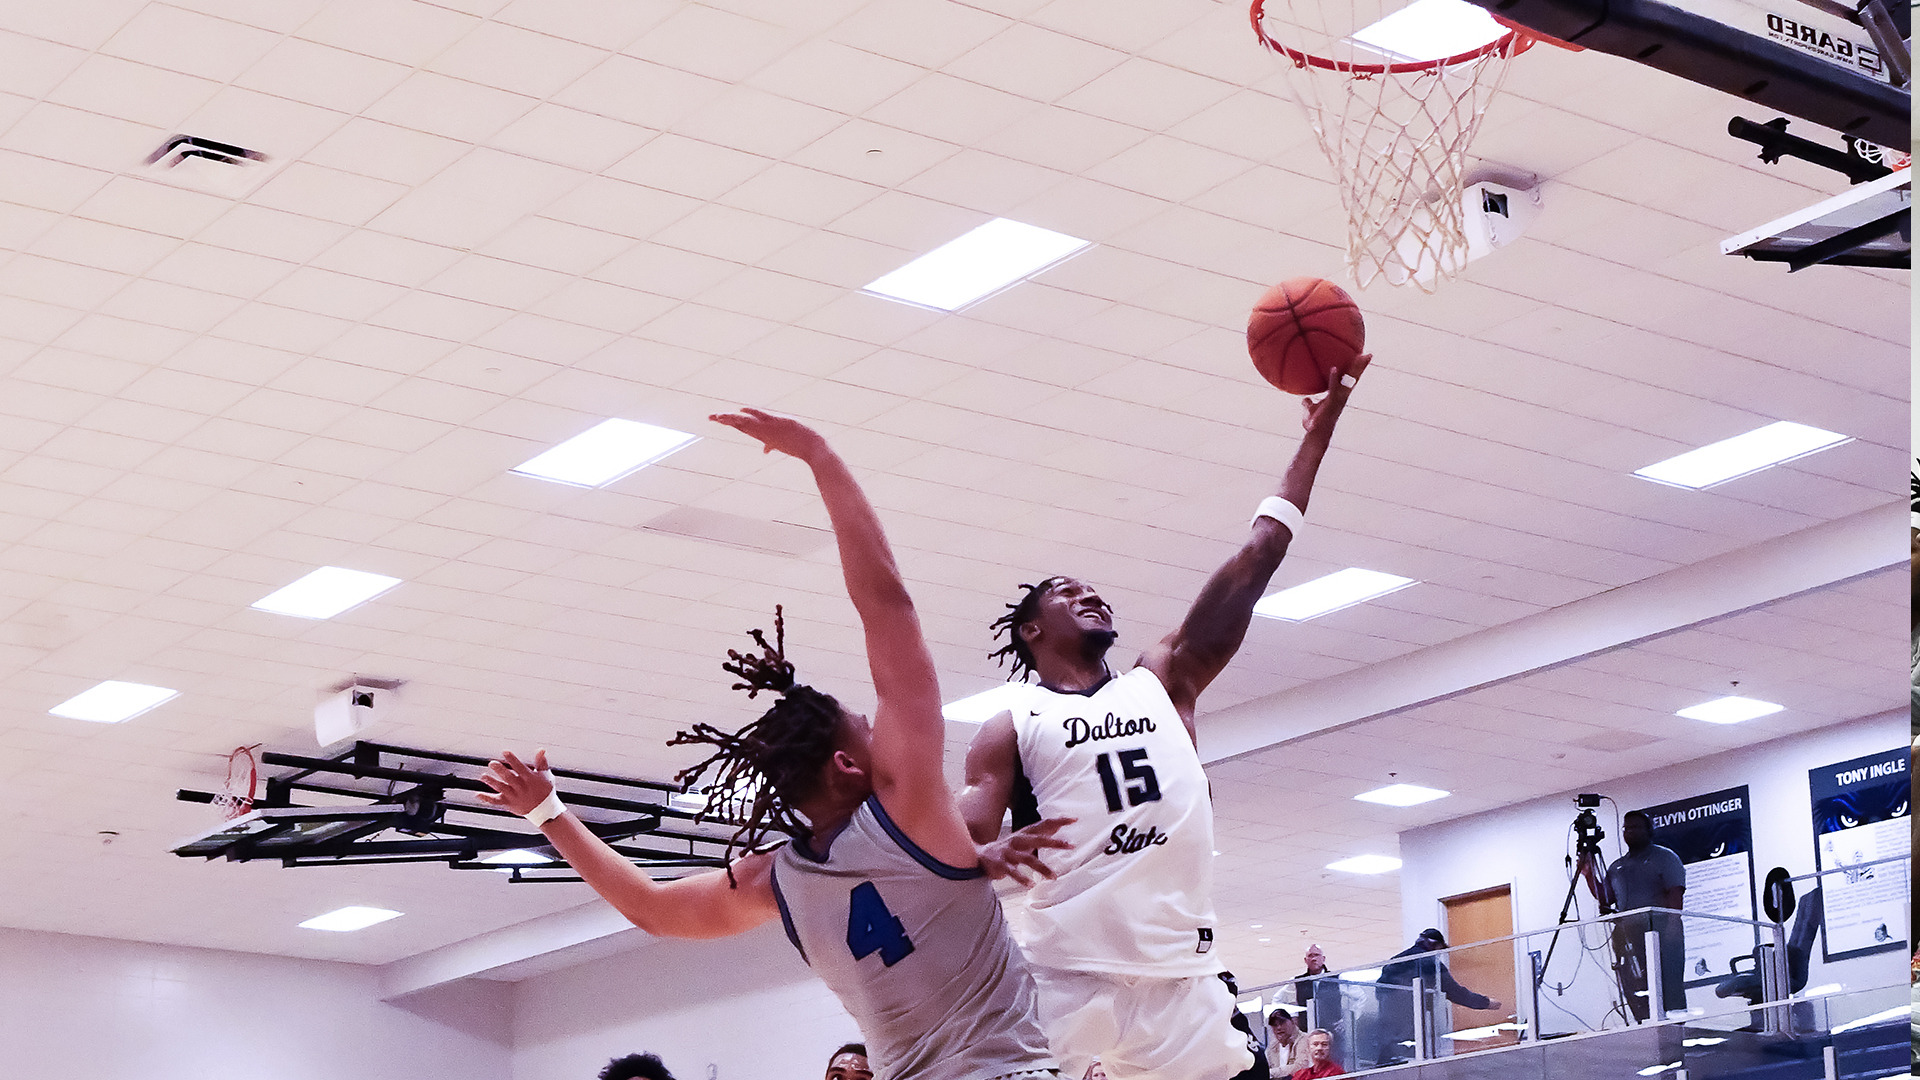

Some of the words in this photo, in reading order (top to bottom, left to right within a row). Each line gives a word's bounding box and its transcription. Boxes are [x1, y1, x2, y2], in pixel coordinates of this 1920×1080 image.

[1063, 712, 1157, 748] Dalton
[1096, 748, 1163, 815] 15
[1835, 766, 1868, 787] TONY
[1869, 758, 1906, 779] INGLE
[1652, 810, 1686, 830] ELVYN
[1687, 797, 1743, 821] OTTINGER
[1104, 823, 1169, 856] State
[847, 881, 915, 967] 4
